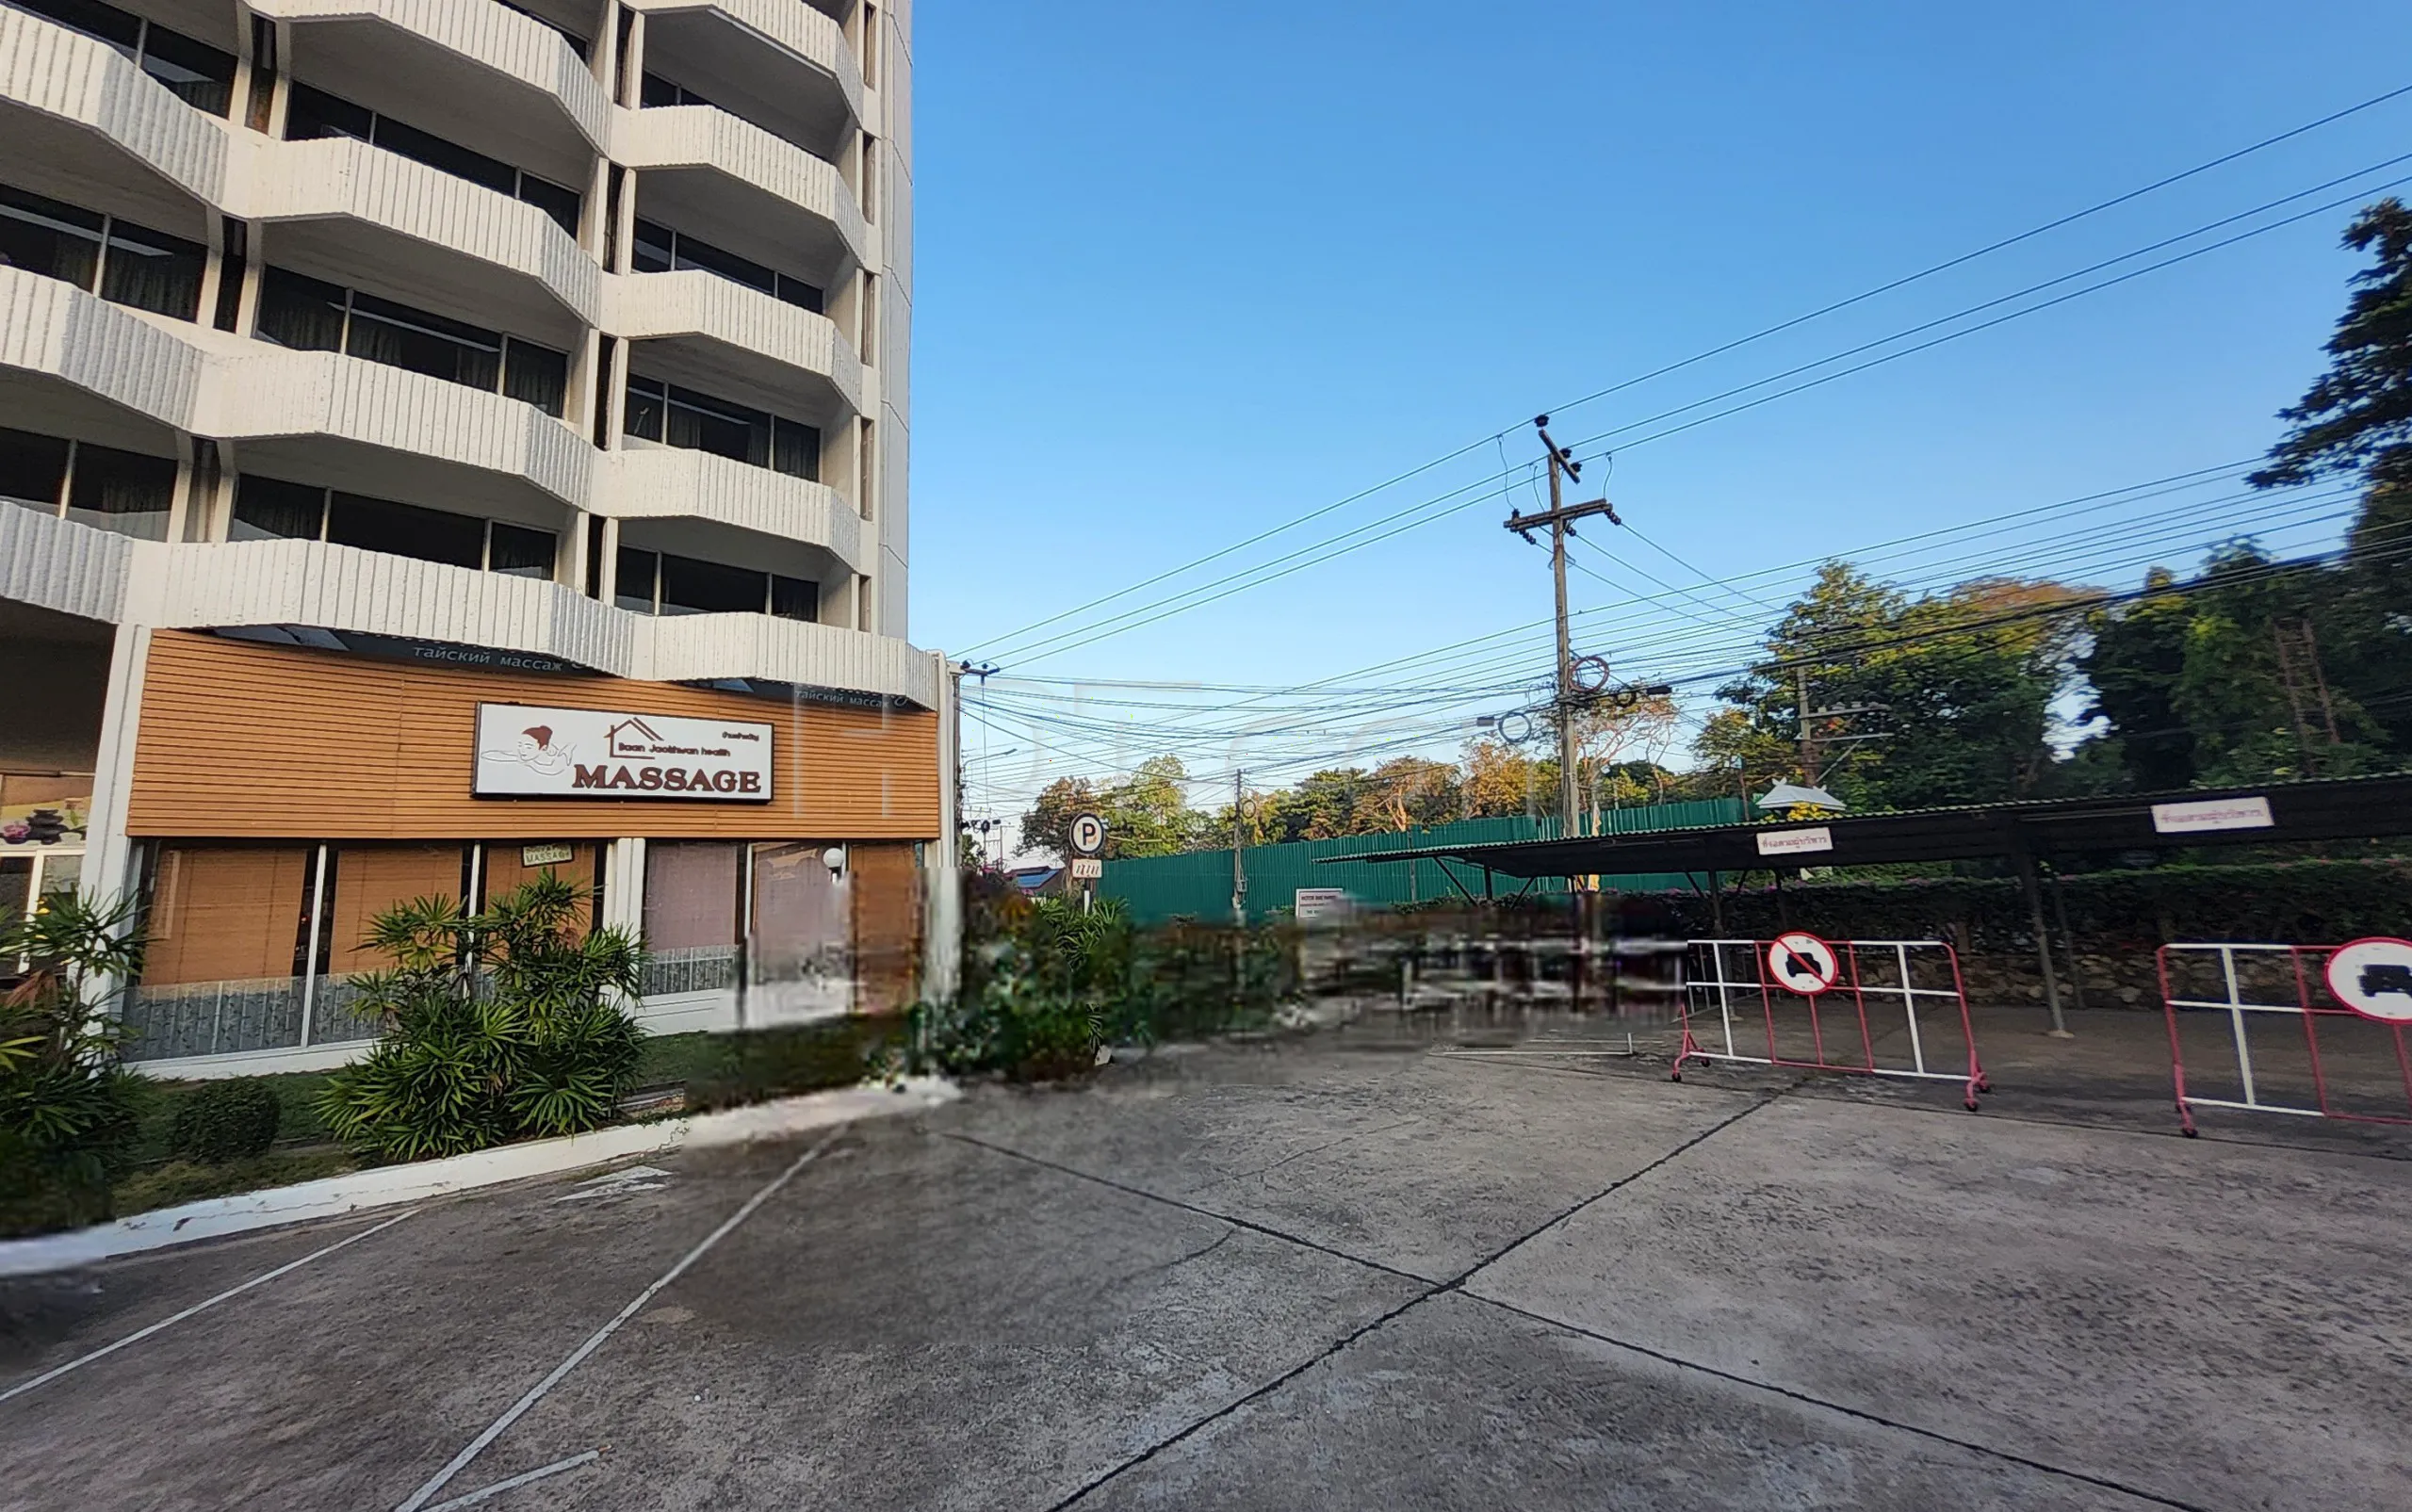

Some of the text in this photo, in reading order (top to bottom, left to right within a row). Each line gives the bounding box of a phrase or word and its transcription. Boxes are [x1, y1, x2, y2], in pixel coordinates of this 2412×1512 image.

[414, 646, 563, 672] тайский массаж
[572, 764, 762, 793] MASSAGE
[1083, 823, 1096, 846] P
